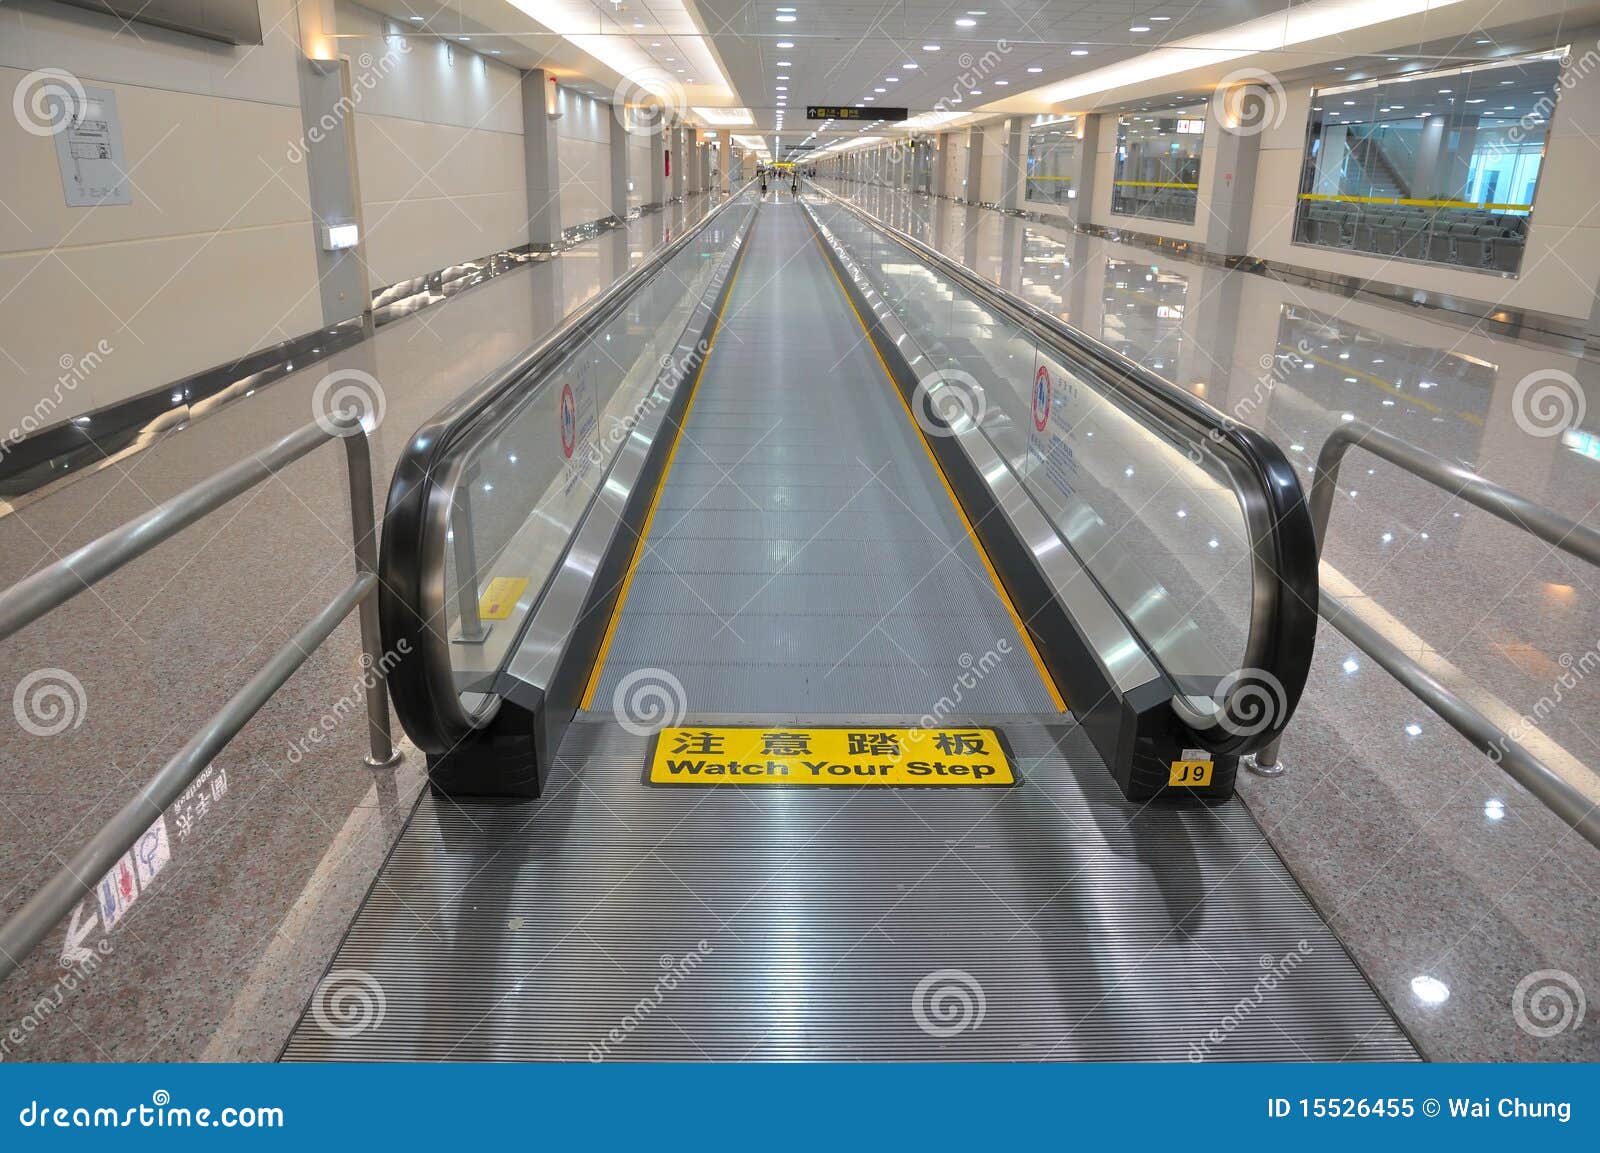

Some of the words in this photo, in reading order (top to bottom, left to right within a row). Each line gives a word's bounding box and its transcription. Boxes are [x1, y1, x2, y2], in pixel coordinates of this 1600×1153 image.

[671, 732, 990, 756] 注意踏板
[667, 760, 789, 776] Watch
[800, 760, 894, 776] Your
[907, 760, 996, 779] Step
